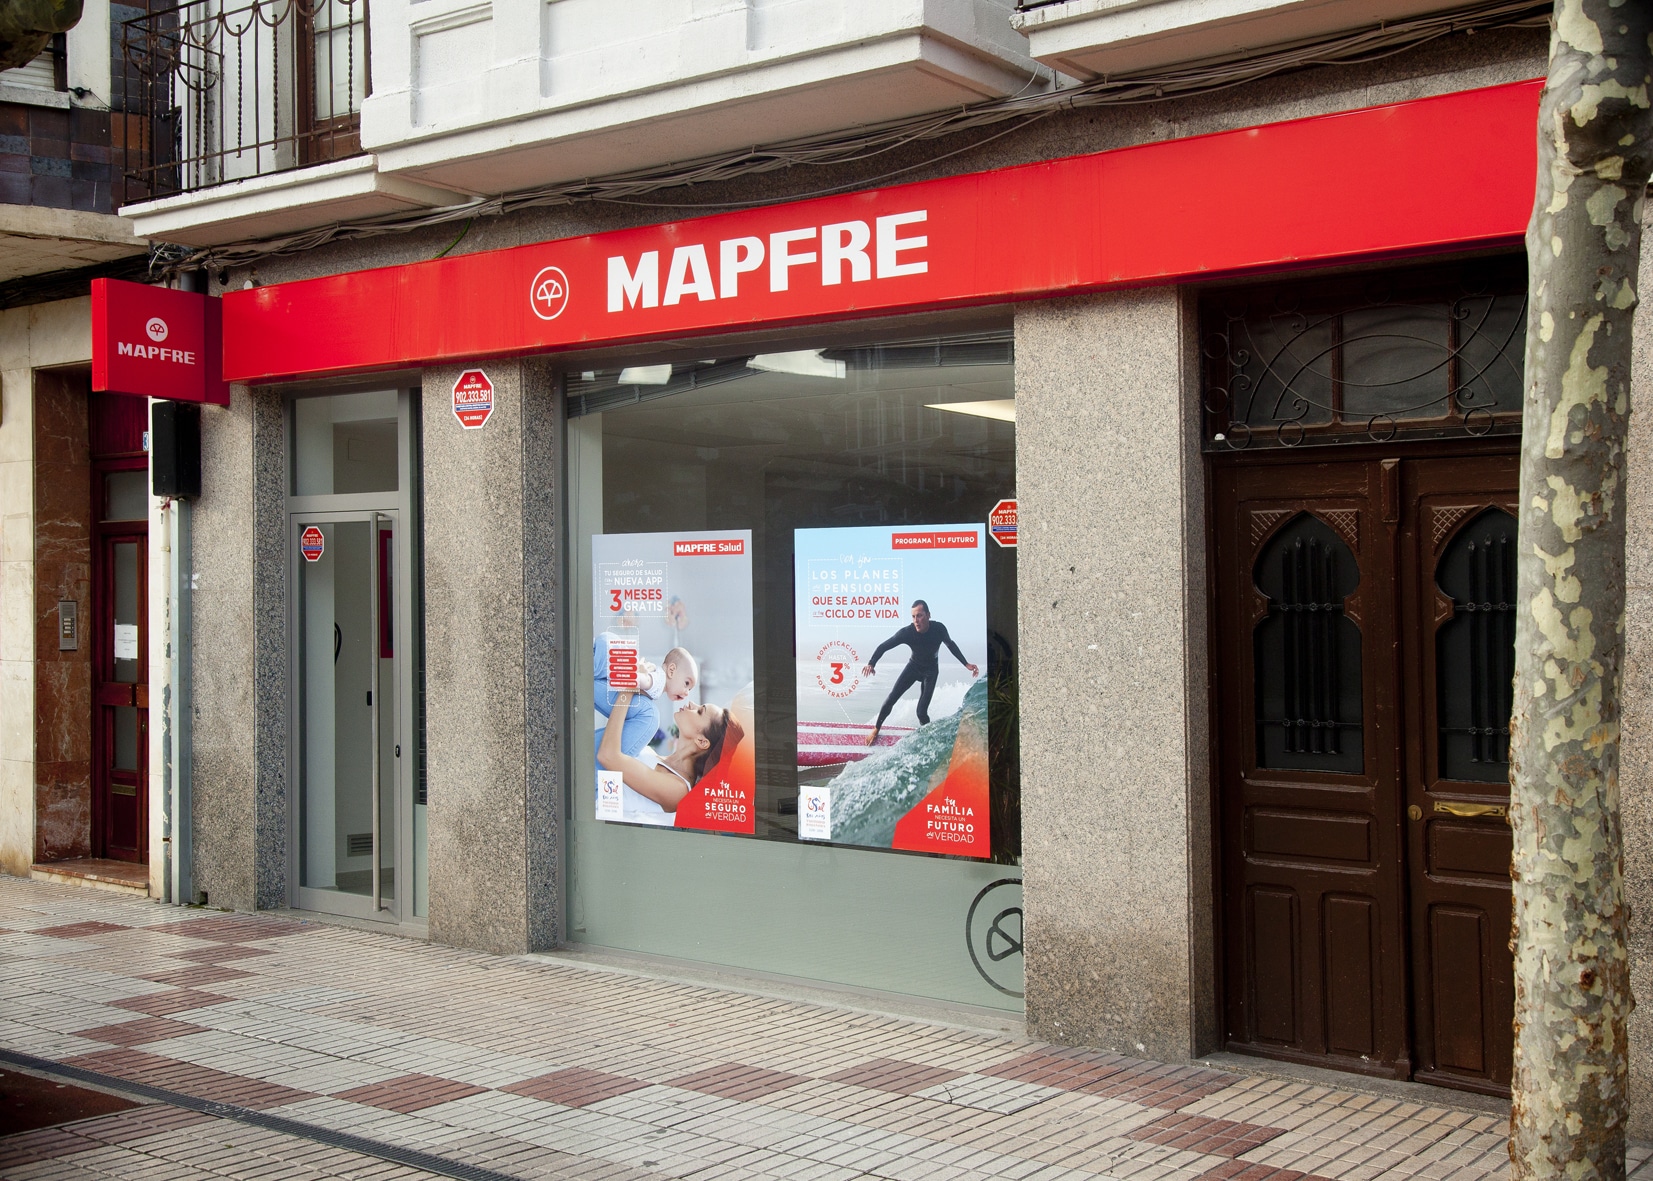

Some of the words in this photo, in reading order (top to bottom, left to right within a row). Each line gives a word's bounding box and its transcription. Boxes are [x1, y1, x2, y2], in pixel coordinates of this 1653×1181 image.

[607, 209, 928, 312] MAPFRE
[117, 341, 196, 365] MAPFRE
[991, 515, 1016, 525] 902.333
[895, 537, 932, 545] PROGRAMA
[947, 536, 975, 544] FUTURO
[676, 544, 717, 553] MAPFRE
[718, 542, 742, 552] Salud
[812, 570, 837, 580] LOS
[844, 569, 899, 580] PLANES
[614, 577, 644, 586] NUEVA
[645, 577, 663, 585] APP
[823, 583, 899, 593] PENSIONES
[610, 589, 622, 612] 3
[624, 588, 663, 600] MESES
[812, 596, 833, 606] QUE
[835, 596, 848, 605] SE
[850, 596, 899, 605] ADAPTAN
[623, 601, 663, 612] GRATIS
[825, 609, 855, 618] CICLO
[858, 609, 871, 618] DE
[874, 609, 899, 618] VIDA
[704, 787, 746, 799] FAMILIA
[704, 802, 746, 813] SEGURO
[926, 804, 974, 817] FAMILIA
[712, 811, 747, 822] VERDAD
[927, 820, 974, 833] FUTURO
[934, 831, 975, 844] VERDAD
